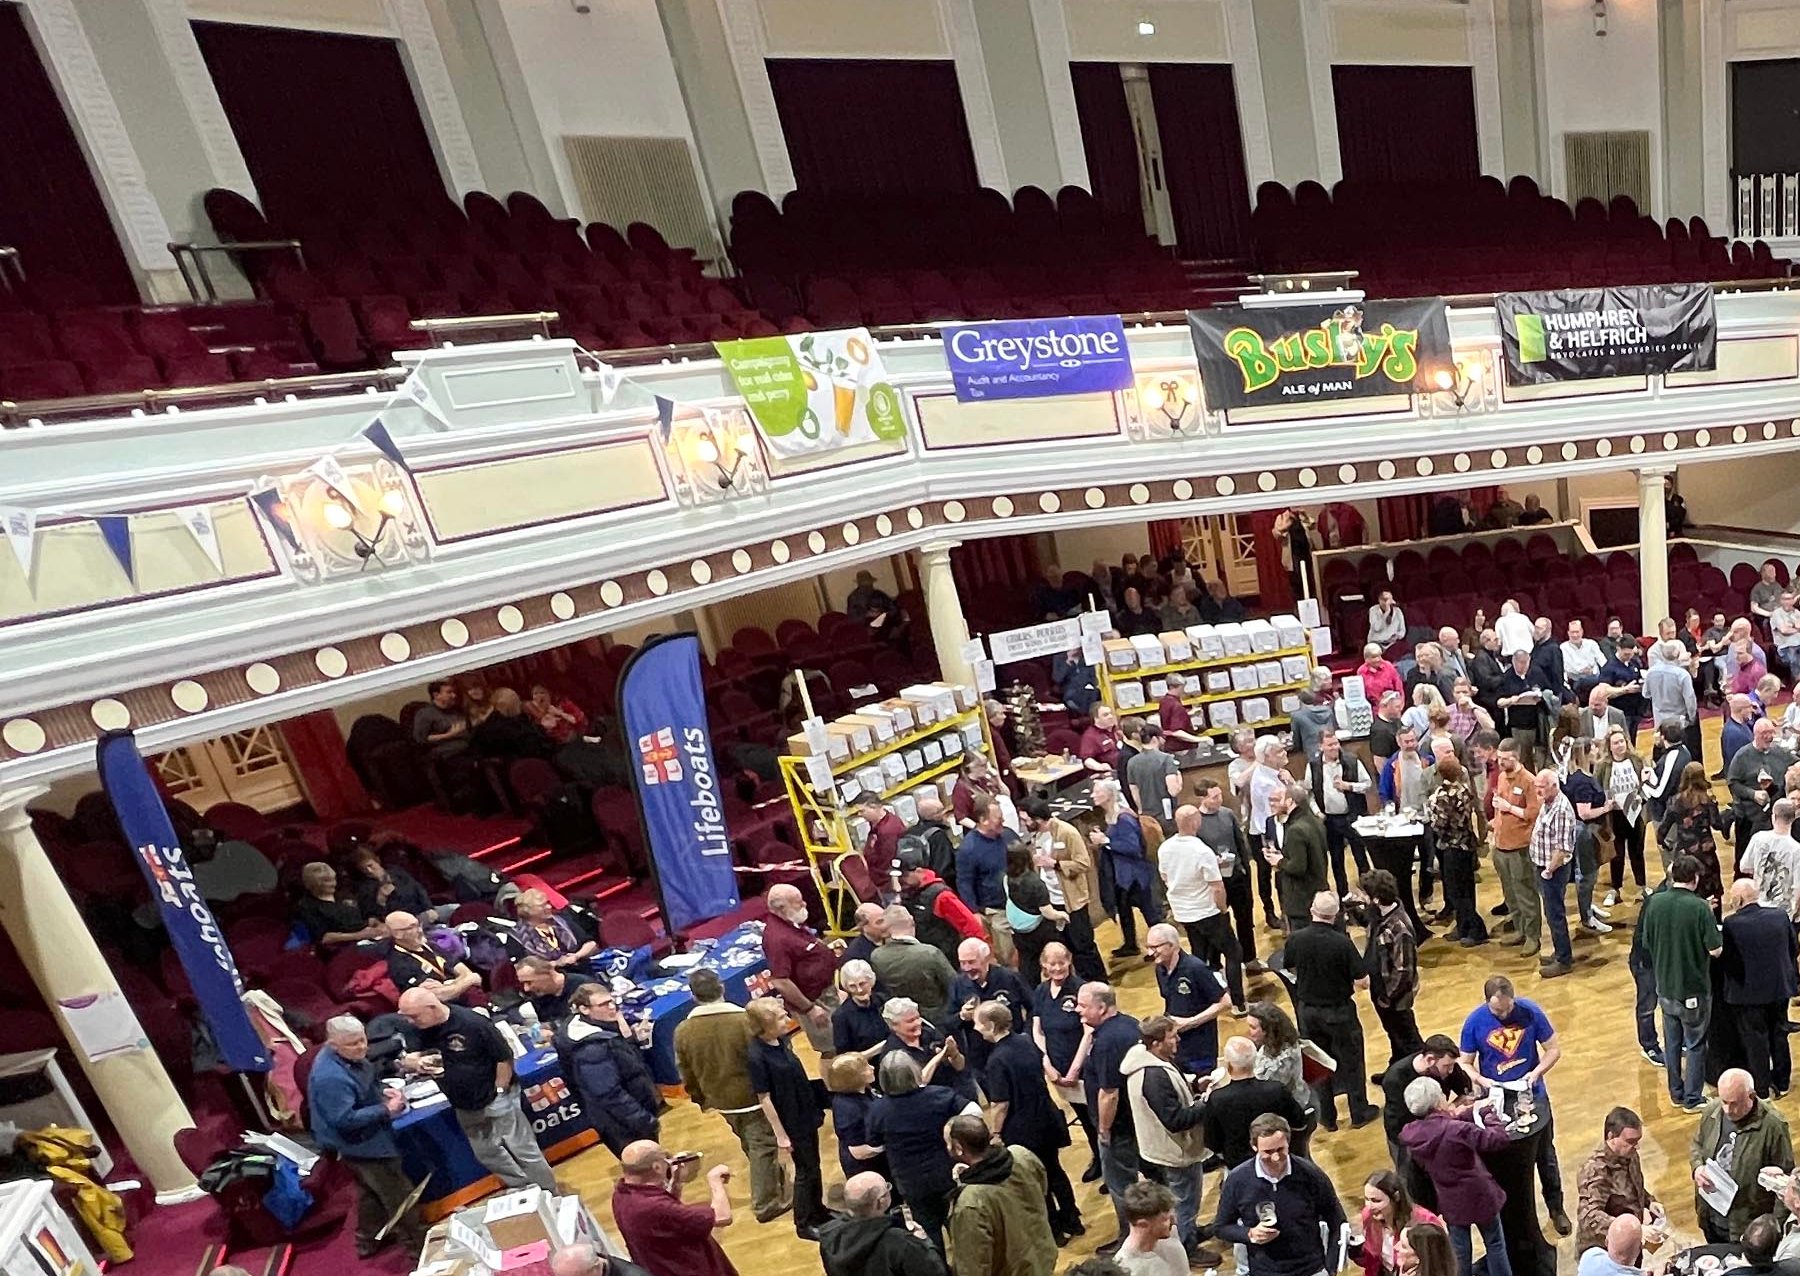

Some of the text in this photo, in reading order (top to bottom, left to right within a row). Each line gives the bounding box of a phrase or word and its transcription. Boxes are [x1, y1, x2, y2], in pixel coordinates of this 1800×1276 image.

[1544, 309, 1639, 331] HUMPHREY
[952, 329, 1119, 370] Greystone
[1549, 327, 1648, 350] & HELFRICH
[1550, 348, 1604, 360] ADVOCATES
[967, 372, 1060, 385] Audit and Accountancy
[1282, 383, 1306, 396] ALE
[1323, 380, 1353, 392] MAN
[683, 726, 730, 857] Lifeboats
